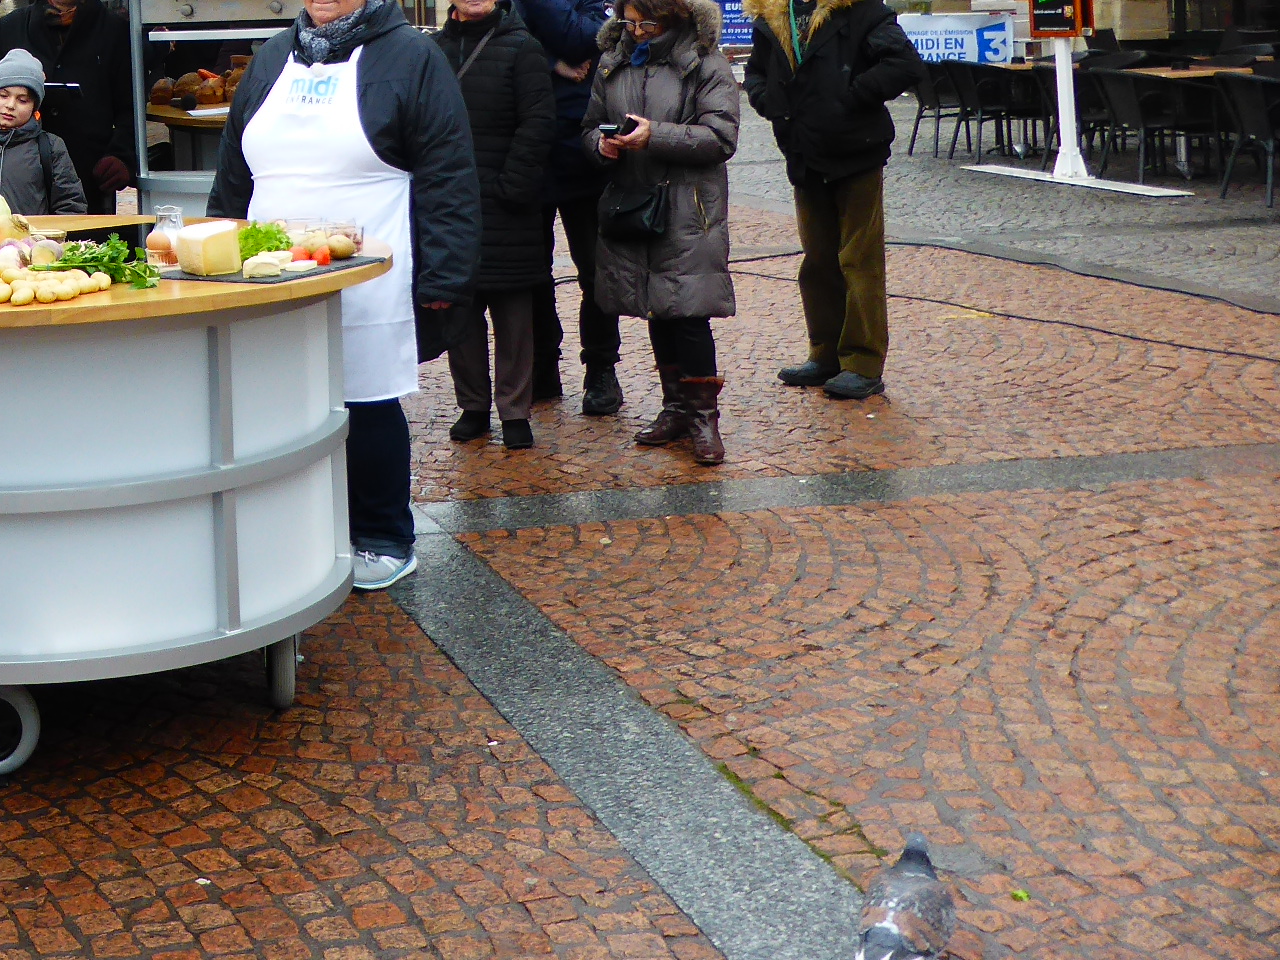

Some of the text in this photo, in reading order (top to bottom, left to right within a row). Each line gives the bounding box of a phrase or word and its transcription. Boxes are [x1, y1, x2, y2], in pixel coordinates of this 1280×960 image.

[725, 3, 742, 11] EU
[944, 37, 965, 50] EN
[983, 31, 1008, 62] 3
[920, 52, 967, 62] ANCE
[289, 76, 340, 97] midi
[295, 96, 333, 105] FRANCE
